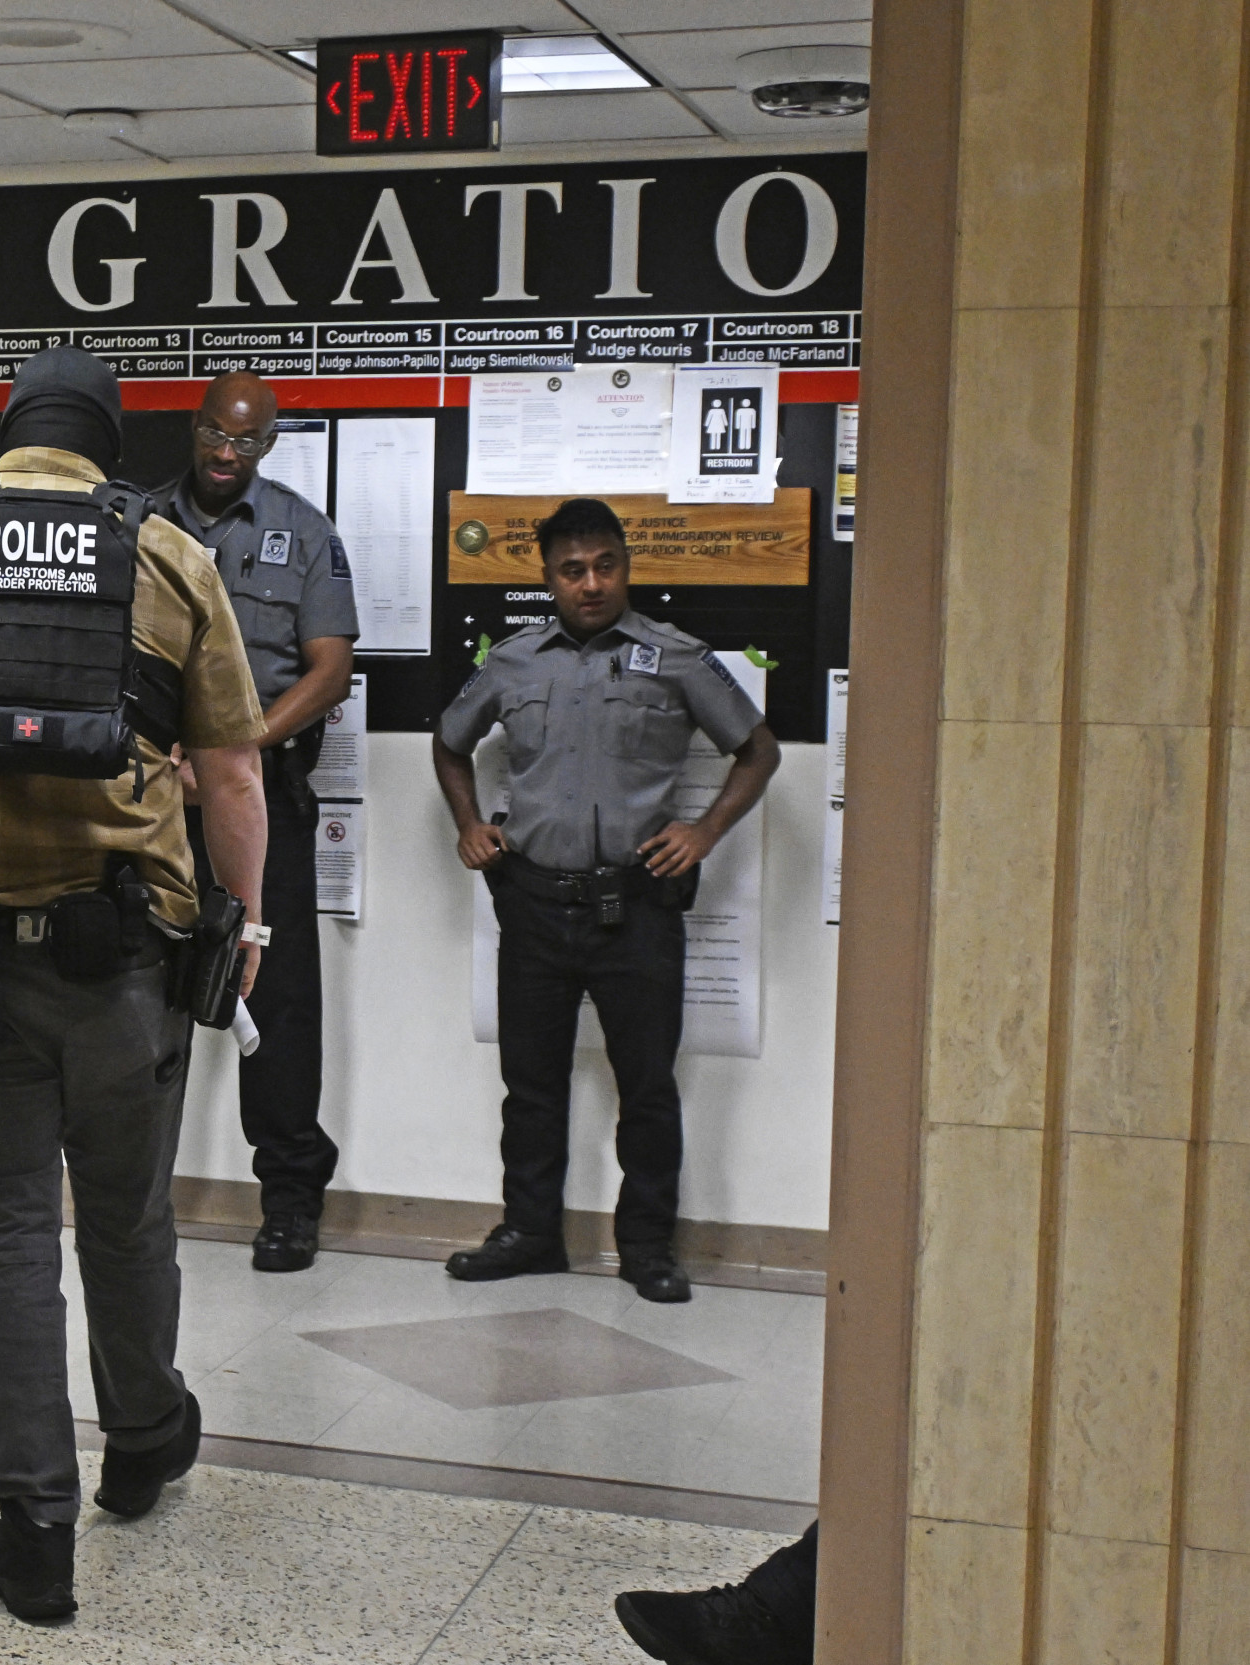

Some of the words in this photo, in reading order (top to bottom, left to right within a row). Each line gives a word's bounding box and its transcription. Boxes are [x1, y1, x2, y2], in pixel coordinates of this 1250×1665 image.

[350, 48, 468, 142] EXIT
[454, 327, 539, 342] Courtroom
[546, 325, 564, 340] 16
[587, 324, 675, 339] Courtroom
[681, 323, 699, 338] 17
[723, 321, 813, 336] Courtroom
[820, 320, 839, 334] 18
[46, 336, 61, 348] 12
[82, 335, 159, 349] Courtroom
[165, 333, 181, 347] 13
[202, 332, 281, 347] Courtroom
[287, 331, 304, 344] 14
[326, 330, 408, 344] Courtroom
[415, 329, 432, 342] 15
[587, 343, 636, 359] Judge
[640, 342, 692, 357] Kouris
[719, 348, 764, 361] Judge
[768, 346, 845, 361] McFarland
[120, 359, 133, 372] C.
[136, 358, 184, 371] Gordon
[204, 357, 246, 372] Judge
[250, 356, 312, 372] Zagzoug
[319, 355, 352, 371] Judge
[354, 354, 439, 368] Johnson-Papillo
[450, 354, 487, 370] Judge
[488, 353, 574, 367] Siemietkowski
[706, 458, 753, 467] RESTROOM
[638, 517, 688, 527] JUSTICE
[653, 531, 732, 541] IMMIGRATION
[736, 531, 784, 541] REVIEW
[506, 545, 533, 555] NEW
[629, 545, 686, 555] IGRATION
[691, 545, 733, 555] COURT
[68, 571, 96, 582] AND
[28, 578, 97, 594] PROTECTION
[505, 591, 555, 601] COURTRO
[505, 615, 546, 624] WAITING
